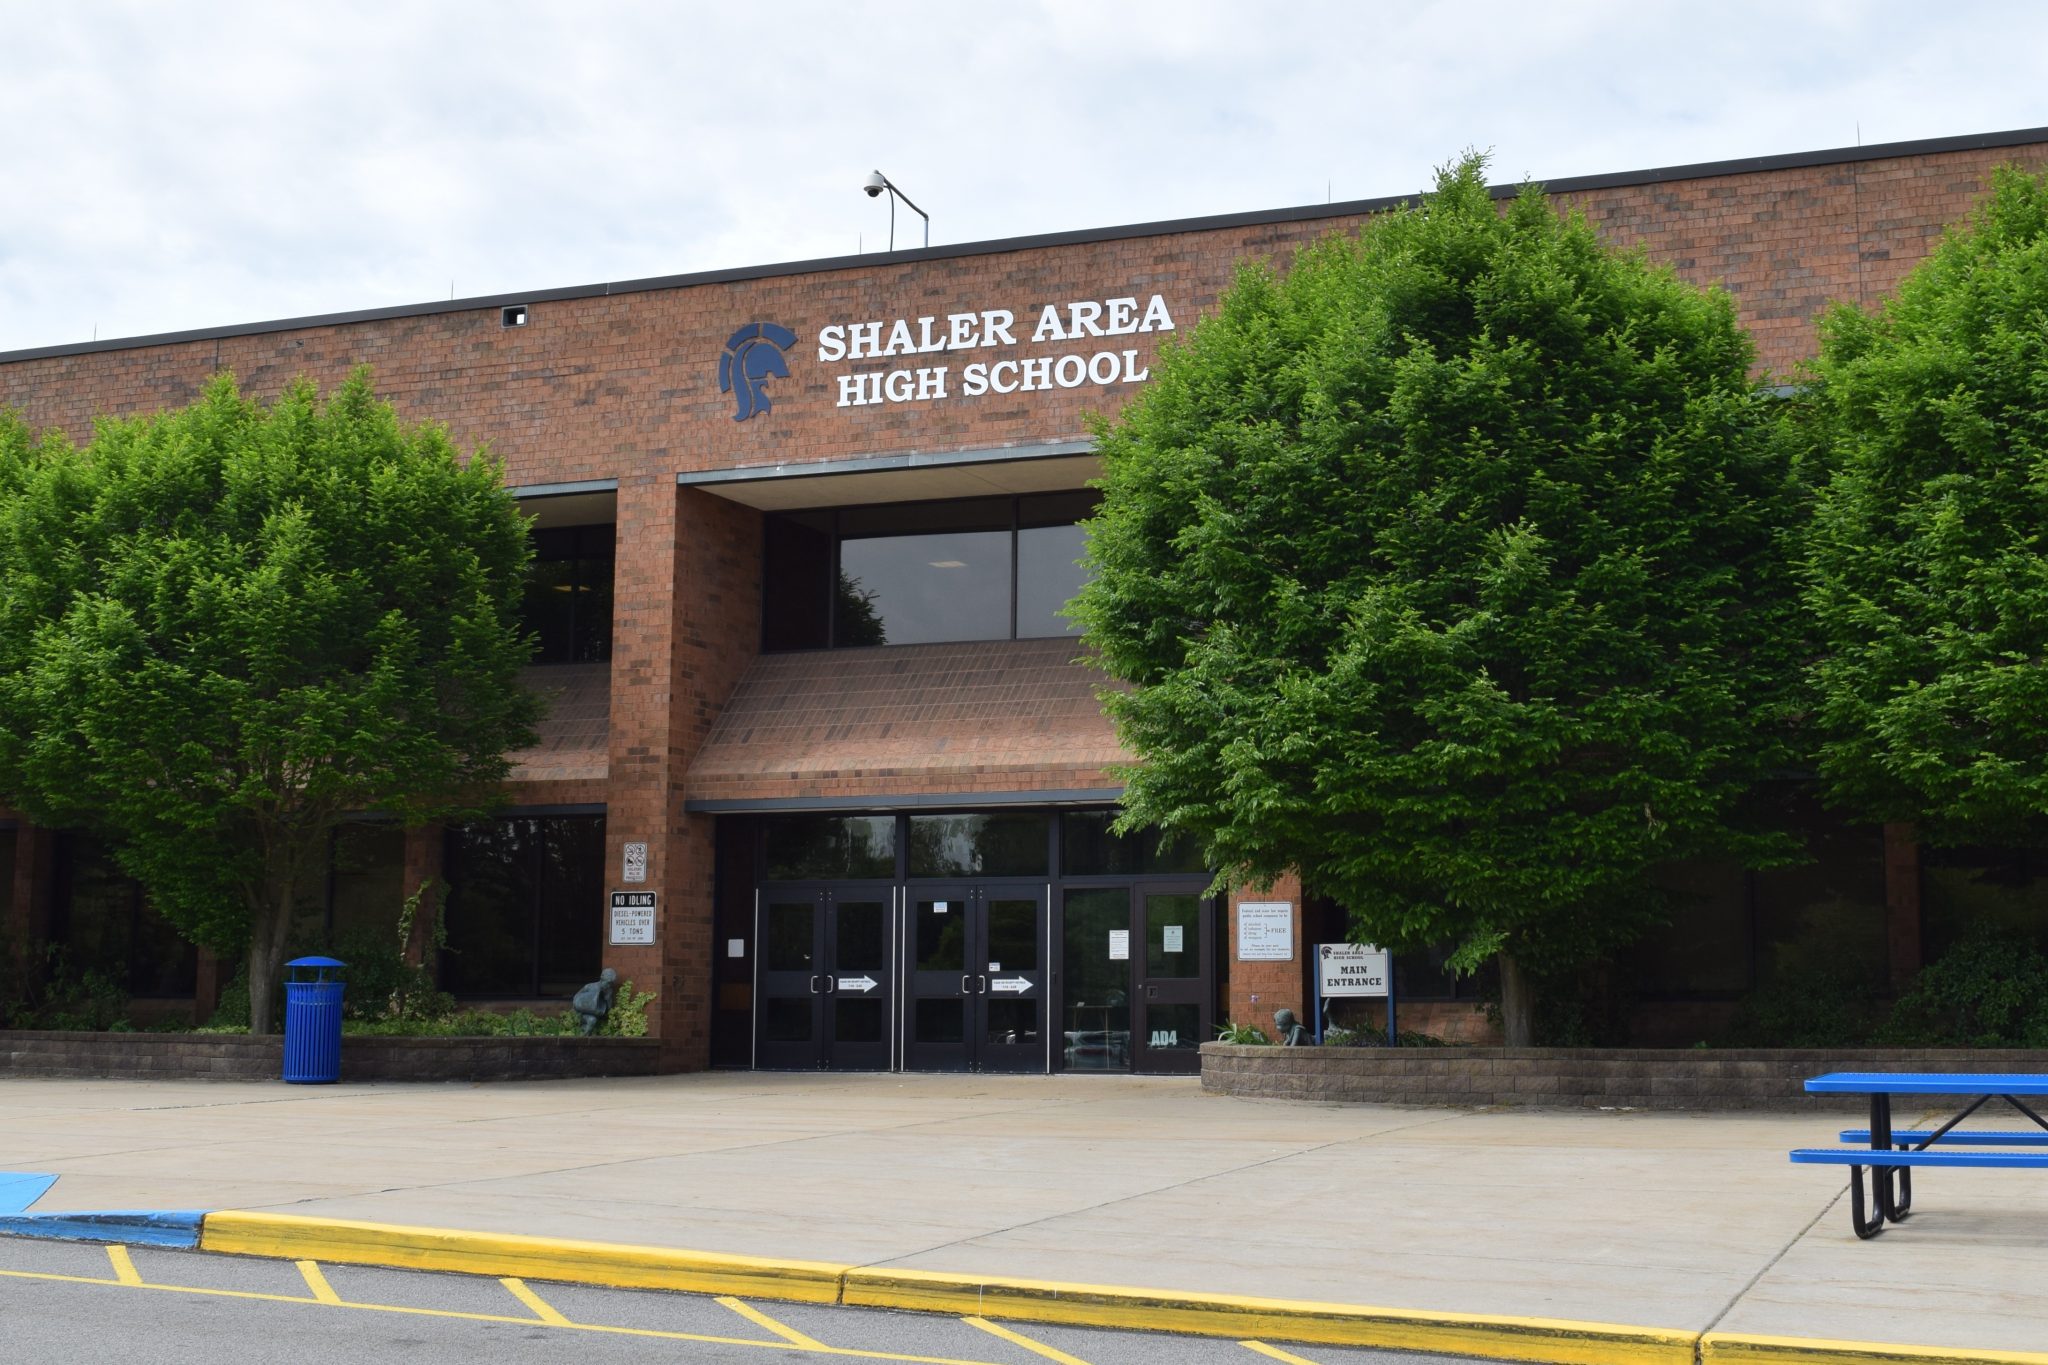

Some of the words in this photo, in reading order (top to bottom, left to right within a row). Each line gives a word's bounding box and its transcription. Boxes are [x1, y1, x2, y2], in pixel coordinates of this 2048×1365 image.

[818, 309, 1017, 362] SHALER
[1031, 294, 1175, 342] AREA
[836, 367, 947, 407] HIGH
[963, 350, 1149, 396] SCHOOL
[615, 895, 625, 905] NO
[628, 895, 652, 905] IDLING
[621, 927, 626, 935] 5
[629, 927, 644, 935] TONS
[1340, 966, 1367, 974] MAIN
[1327, 977, 1382, 986] ENTRANCE
[1151, 1030, 1177, 1046] AD4
